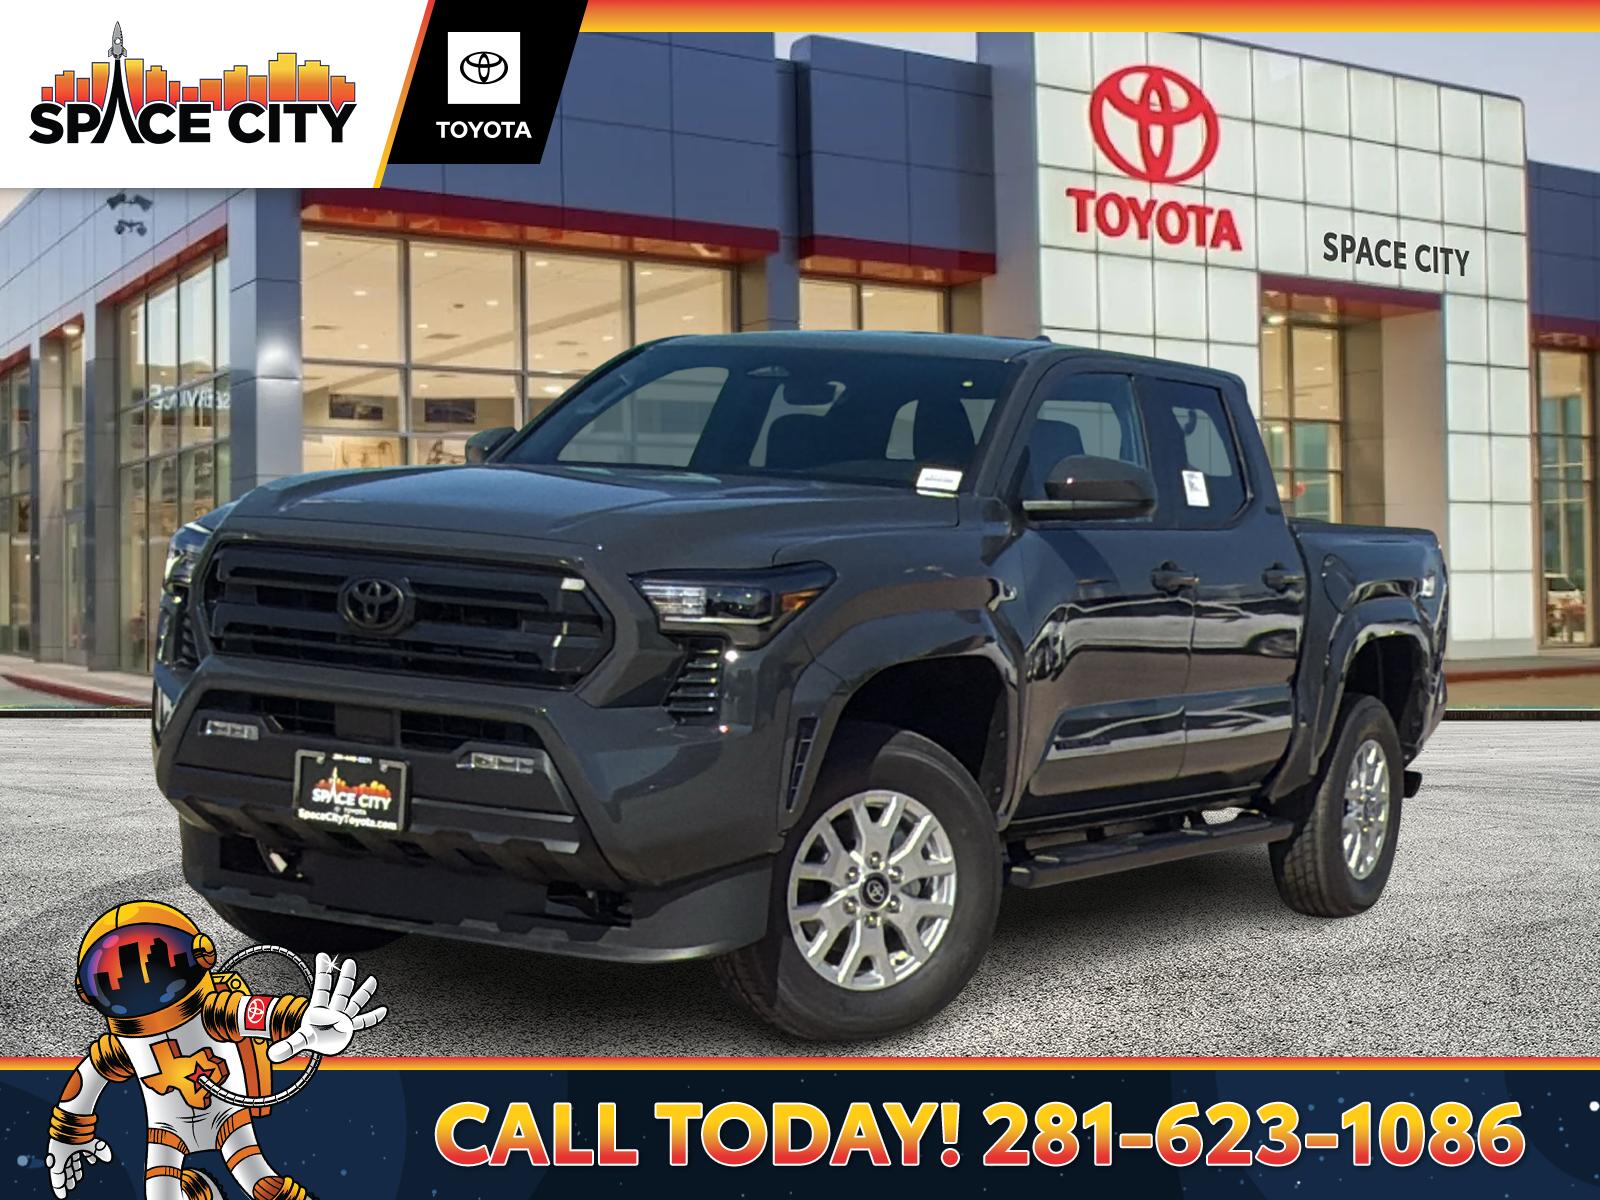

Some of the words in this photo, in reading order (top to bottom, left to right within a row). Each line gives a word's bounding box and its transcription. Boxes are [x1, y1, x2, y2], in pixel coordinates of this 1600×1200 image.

[1066, 187, 1243, 252] TOYOTA
[1322, 232, 1407, 270] SPACE
[1414, 243, 1470, 277] CITY
[312, 788, 356, 805] SPACE
[358, 795, 391, 809] CITY
[298, 808, 397, 830] SpaceCityToyota.com
